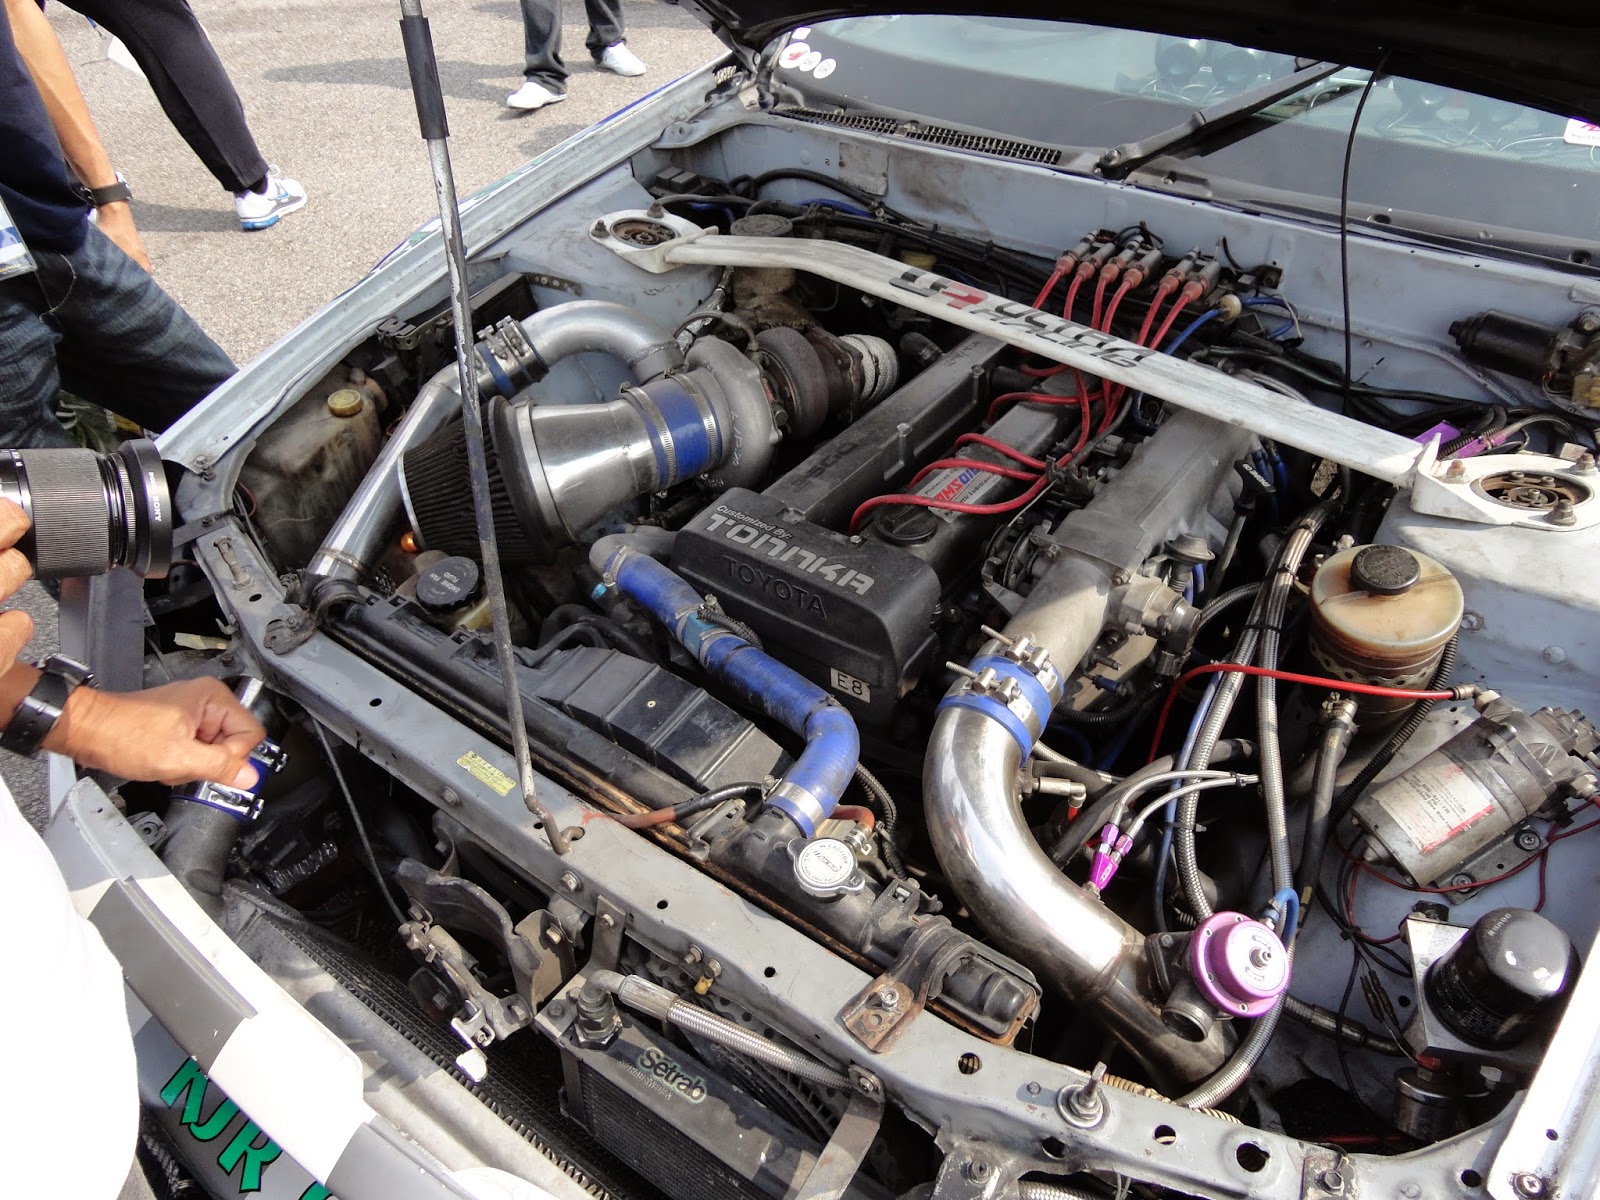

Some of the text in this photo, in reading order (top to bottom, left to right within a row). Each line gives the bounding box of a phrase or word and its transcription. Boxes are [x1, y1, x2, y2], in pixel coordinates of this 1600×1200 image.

[969, 308, 1138, 368] RACING
[994, 302, 1157, 361] ULTRA
[152, 495, 162, 522] SONY
[717, 505, 793, 540] Customized By:
[440, 579, 461, 594] ENGINE
[443, 571, 460, 583] FLUID
[722, 554, 828, 620] TOYOTA
[835, 675, 864, 697] E8
[637, 1047, 707, 1104] Setrab
[159, 1055, 284, 1195] KJR
